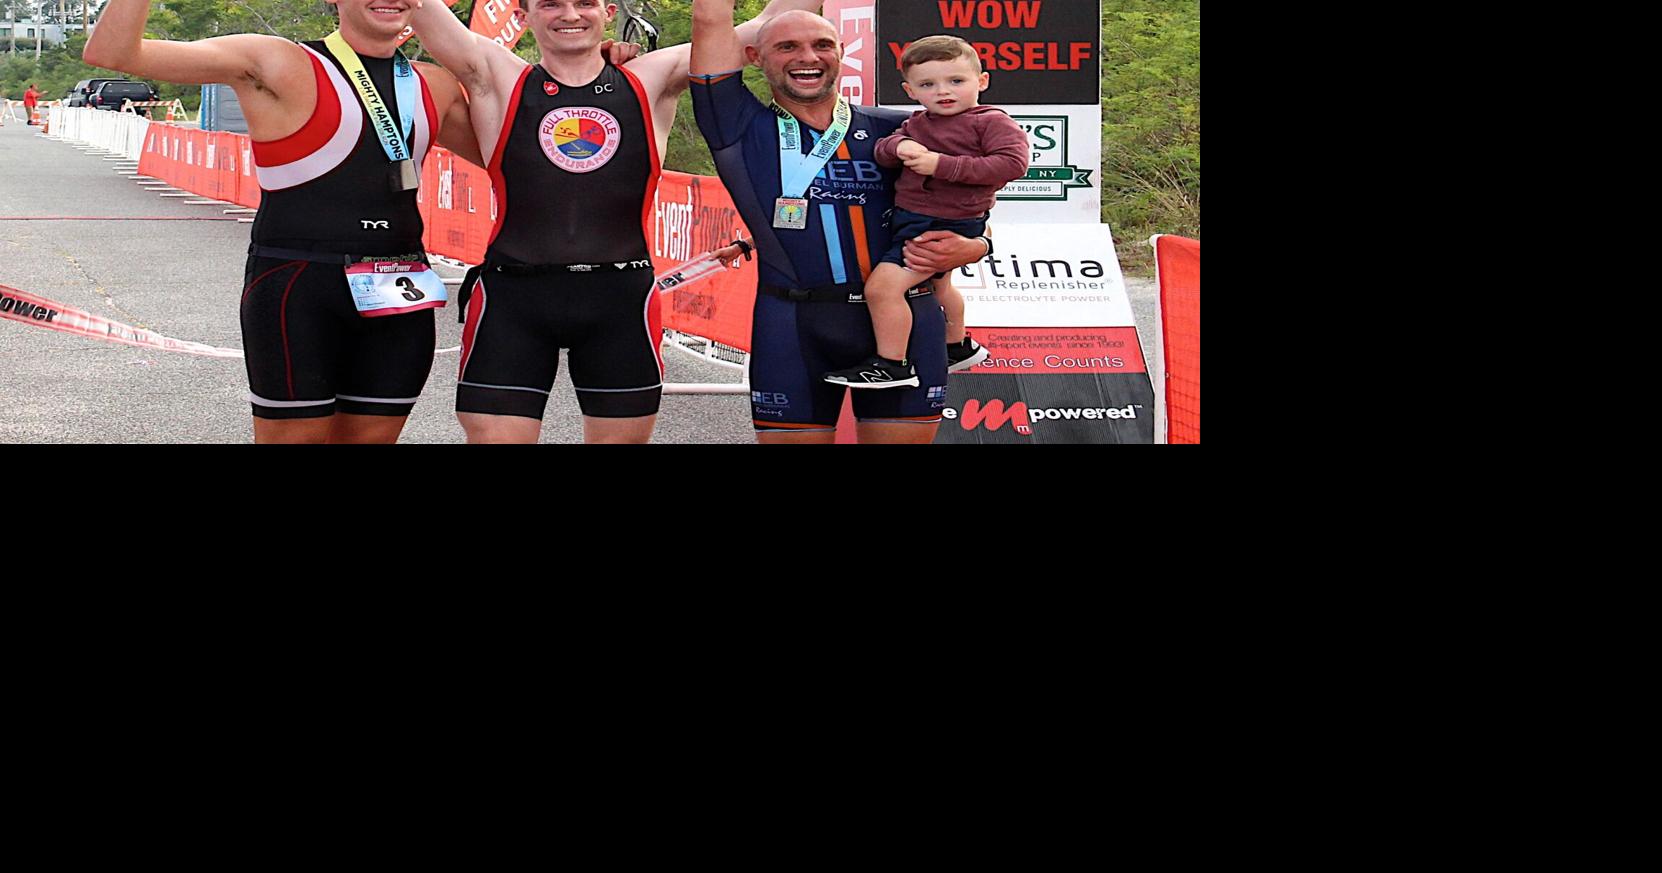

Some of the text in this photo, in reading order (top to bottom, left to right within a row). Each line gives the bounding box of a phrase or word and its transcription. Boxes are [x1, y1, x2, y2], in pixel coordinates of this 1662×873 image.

[938, 0, 1041, 28] WOW
[888, 41, 1092, 70] YRSELF
[594, 83, 613, 94] DC
[354, 70, 379, 104] MIGHTY
[374, 106, 404, 160] HAMPTONS
[543, 110, 617, 135] FULL THROTTLE
[543, 138, 617, 169] ENDURANCE
[827, 160, 882, 181] EB
[1039, 170, 1057, 178] NY
[809, 186, 867, 205] Racing
[833, 182, 884, 191] BURMAN
[361, 220, 389, 229] TYR
[654, 185, 693, 262] Event
[630, 259, 650, 269] TYR
[395, 276, 425, 302] 3
[996, 280, 1105, 291] Replenisher
[988, 334, 1032, 342] Creating
[1056, 334, 1107, 343] producing
[1044, 354, 1124, 369] Counts
